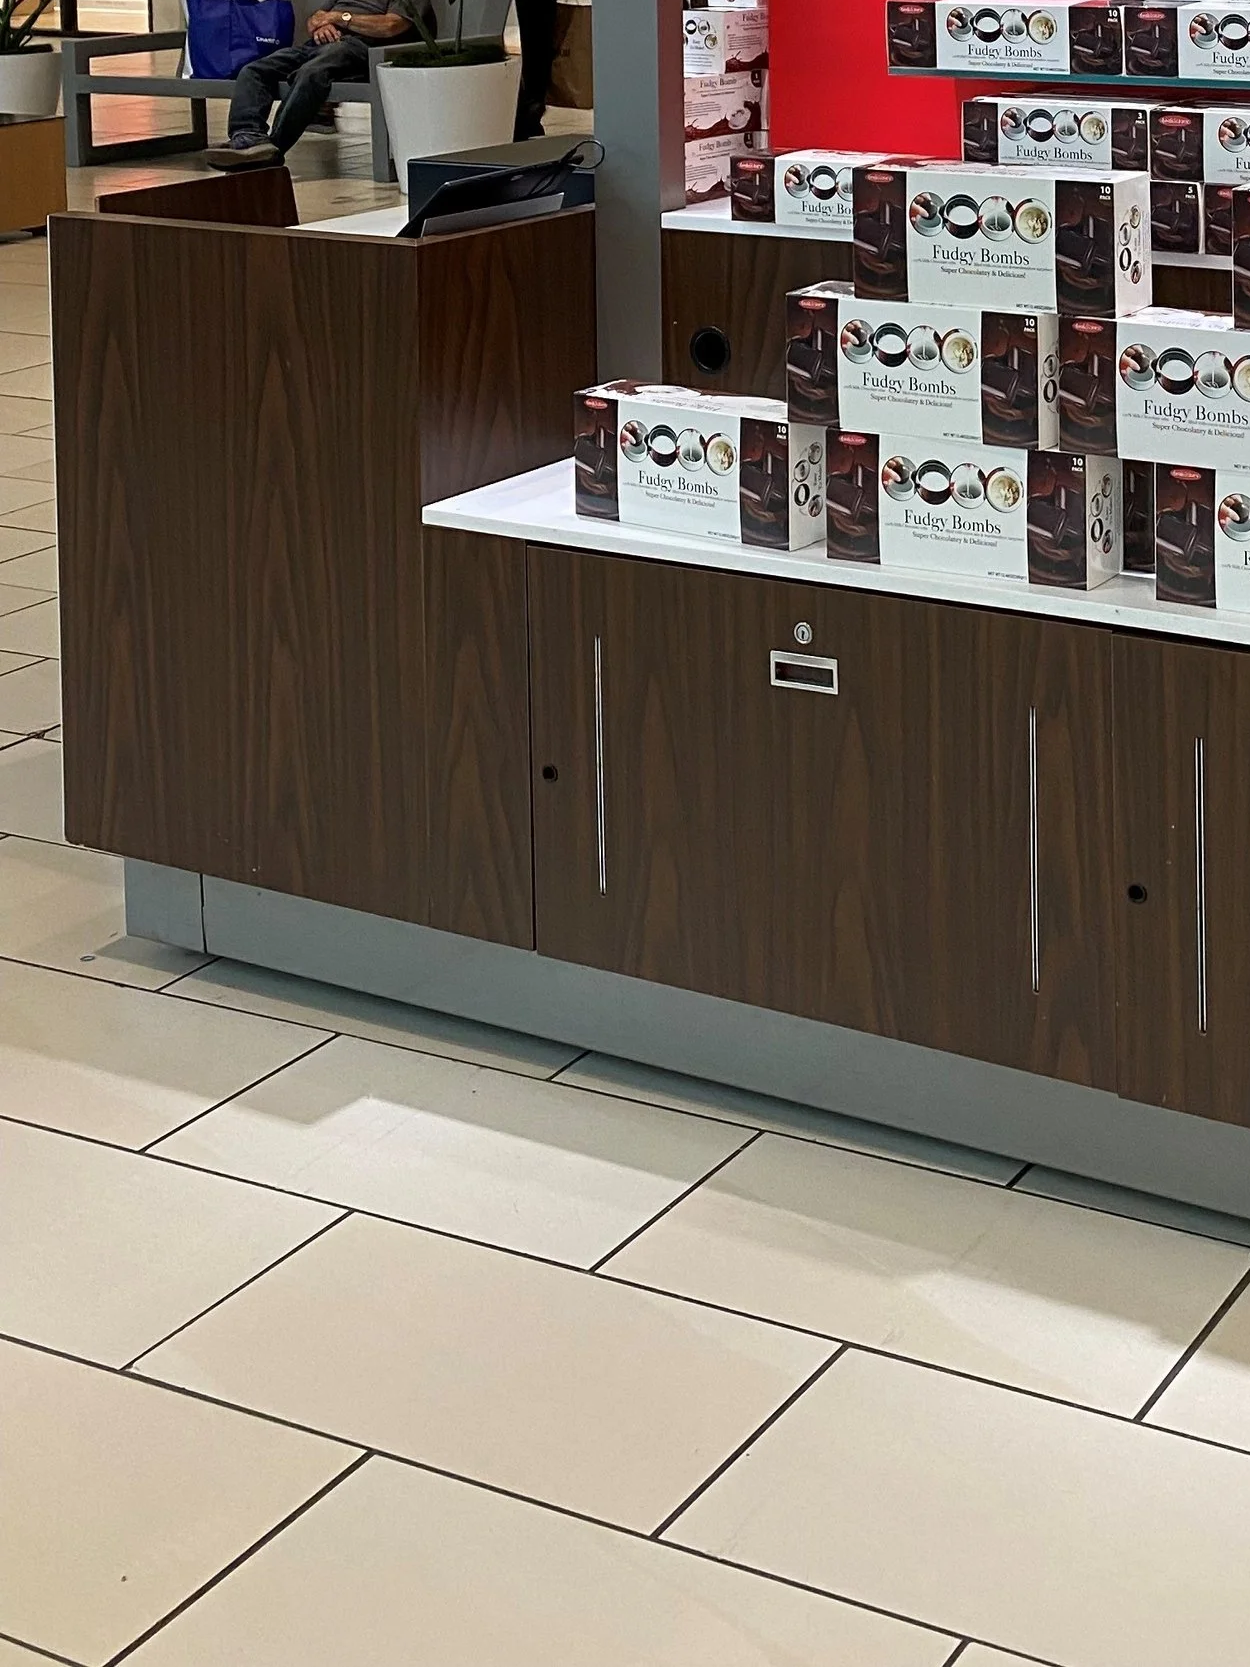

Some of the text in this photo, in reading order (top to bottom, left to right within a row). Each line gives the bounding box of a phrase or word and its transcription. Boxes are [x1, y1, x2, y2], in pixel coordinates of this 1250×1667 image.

[968, 44, 1042, 59] Fudgy Bombs
[1212, 52, 1249, 67] Fudgy
[1016, 145, 1092, 160] Fudgy Bombs
[1100, 186, 1111, 195] 10
[1187, 186, 1193, 194] 5
[801, 201, 834, 216] Fudgy
[932, 245, 1030, 265] Fudgy Bombs
[941, 266, 957, 275] Super
[1024, 318, 1035, 326] 10
[862, 372, 956, 395] Fudgy Bombs
[1143, 399, 1249, 425] Fudgy Bombs
[777, 425, 787, 433] 10
[1072, 457, 1083, 466] 10
[638, 470, 719, 496] Fudgy Bombs
[904, 509, 1001, 534] Fudgy Bombs
